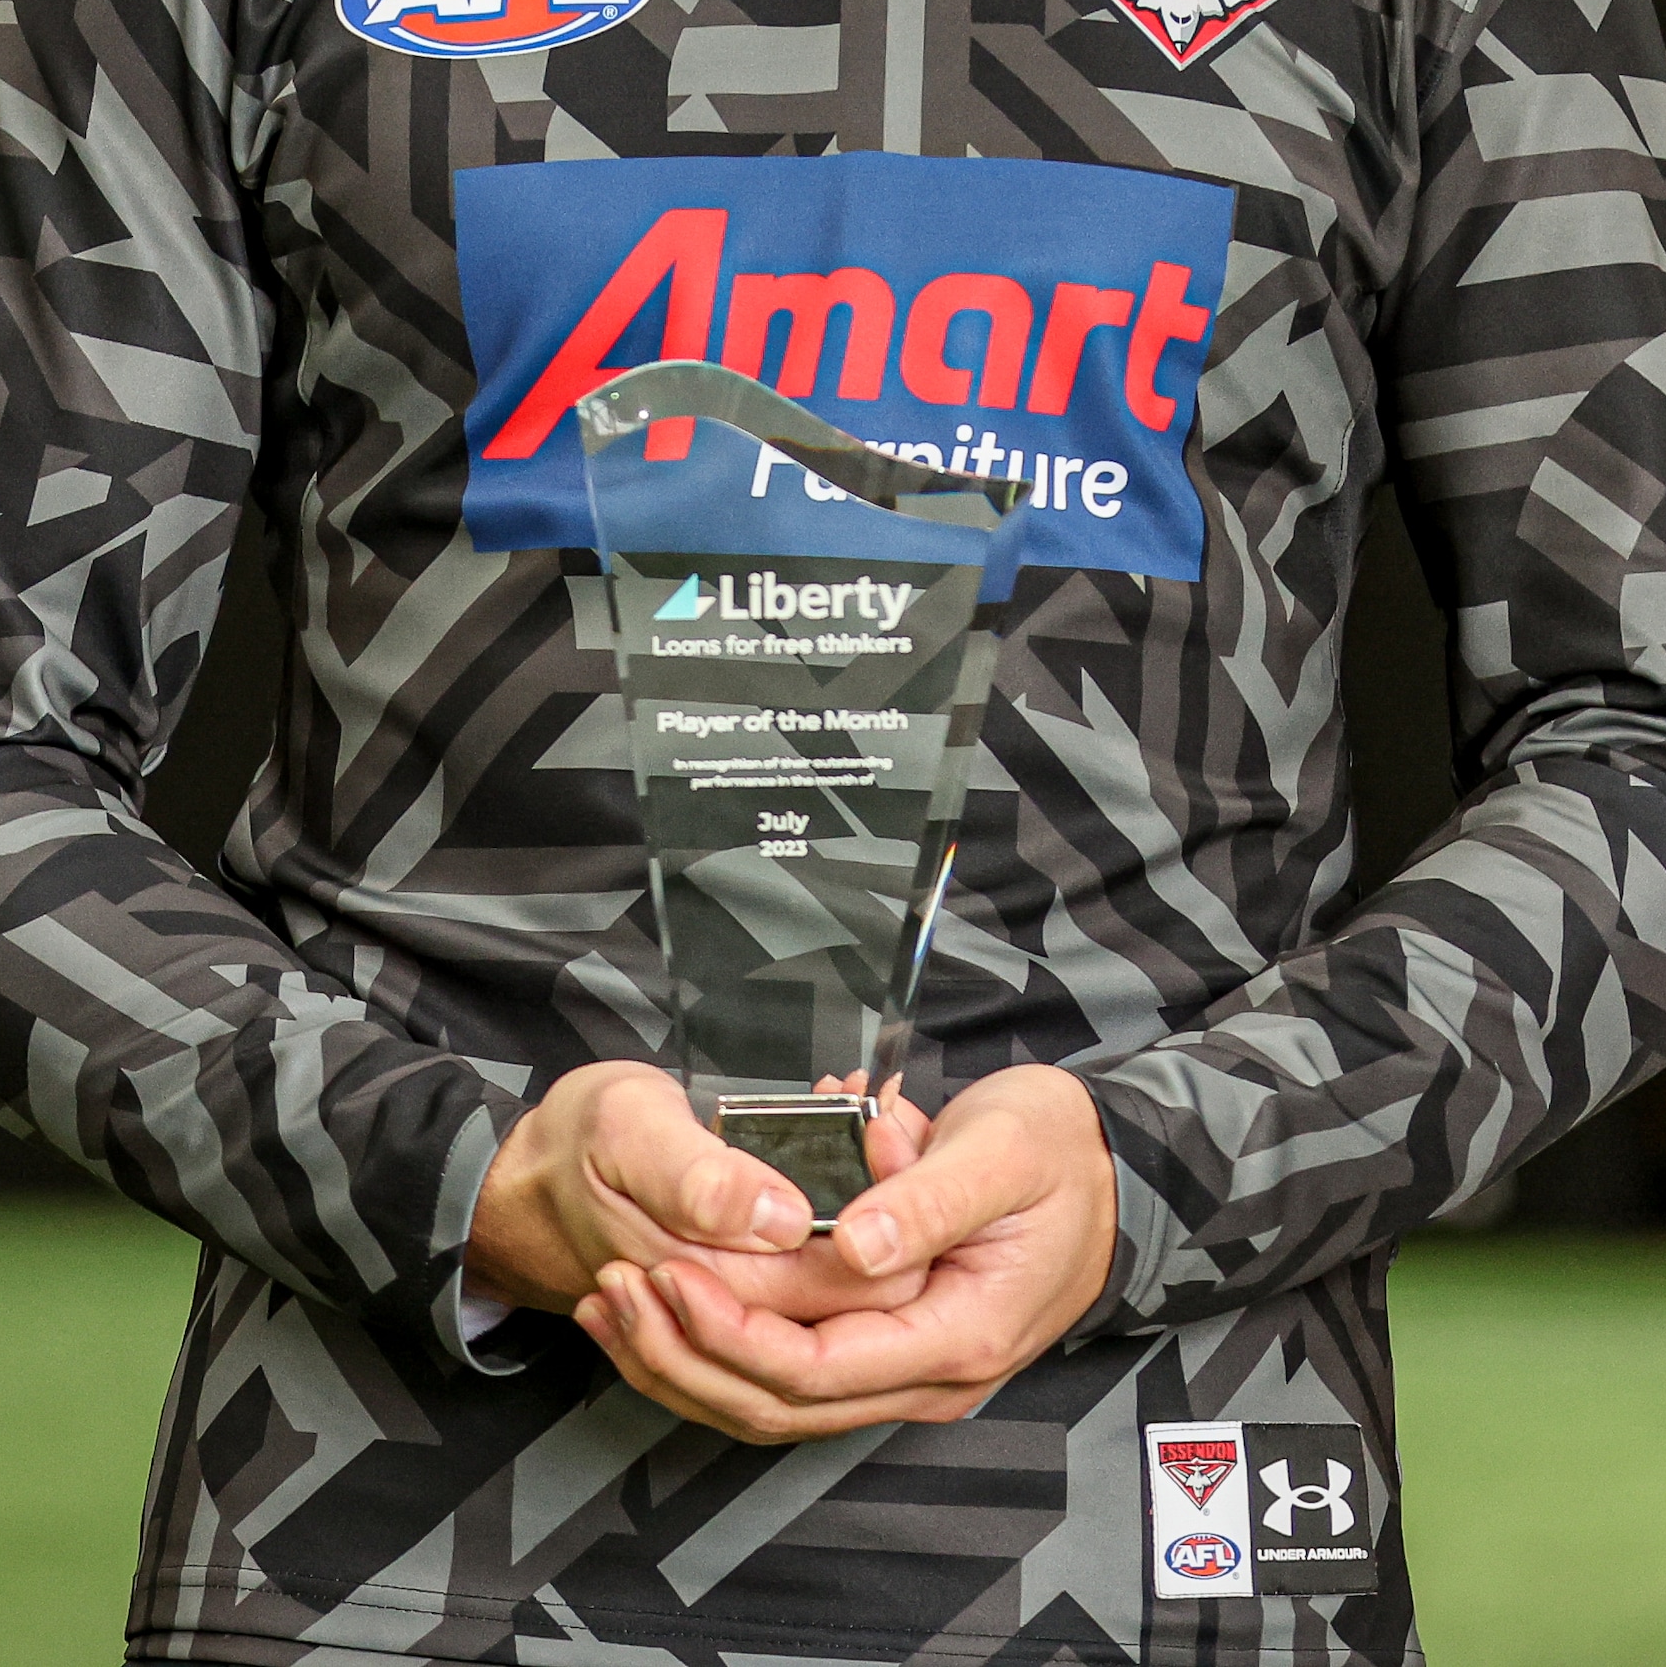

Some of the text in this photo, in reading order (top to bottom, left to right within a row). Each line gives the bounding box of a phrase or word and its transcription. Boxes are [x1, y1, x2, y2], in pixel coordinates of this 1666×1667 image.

[482, 208, 1211, 461] Amart
[719, 571, 913, 632] Liberty
[652, 633, 913, 656] Loans for free thinkers
[656, 708, 909, 738] Player of the Month
[763, 756, 779, 770] of
[814, 773, 859, 787] month
[757, 811, 810, 835] July
[758, 840, 808, 858] 2023
[1159, 1442, 1237, 1461] ESSENDON
[1170, 1544, 1235, 1569] AFL
[1256, 1547, 1361, 1561] UNDER ARMOUR
